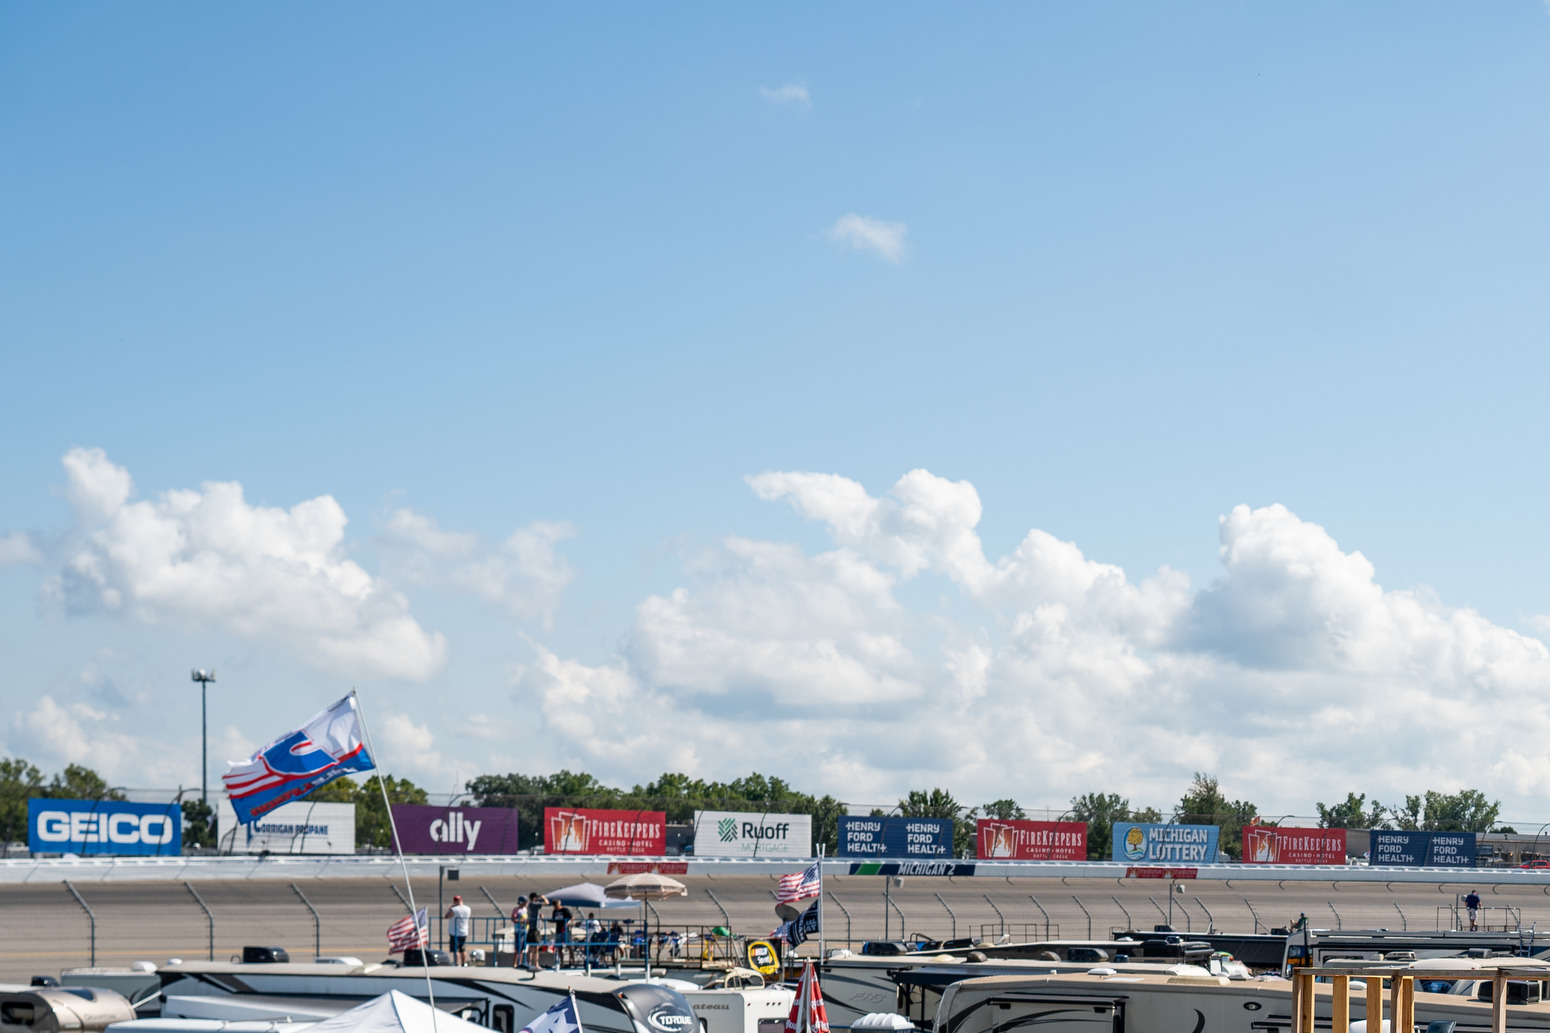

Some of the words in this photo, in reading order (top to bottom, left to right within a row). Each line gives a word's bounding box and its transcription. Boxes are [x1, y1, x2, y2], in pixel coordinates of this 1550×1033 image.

[37, 811, 173, 845] GEICO
[429, 811, 482, 851] ally
[742, 822, 790, 840] Ruoff
[845, 821, 881, 832] HENRY
[906, 823, 940, 834] HENRY
[847, 832, 873, 842] FORD
[907, 834, 932, 844] FORD
[1149, 828, 1208, 843] MICHIGAN
[1378, 835, 1409, 845] HENRY
[598, 839, 626, 847] CASINO
[1432, 837, 1464, 846] HENRY
[1149, 843, 1207, 860] LOTTERY
[1378, 845, 1402, 853] FORD
[1433, 846, 1457, 854] FORD
[898, 863, 946, 875] MICHIGAN
[947, 864, 956, 875] 2
[660, 1016, 693, 1025] TORQUE
